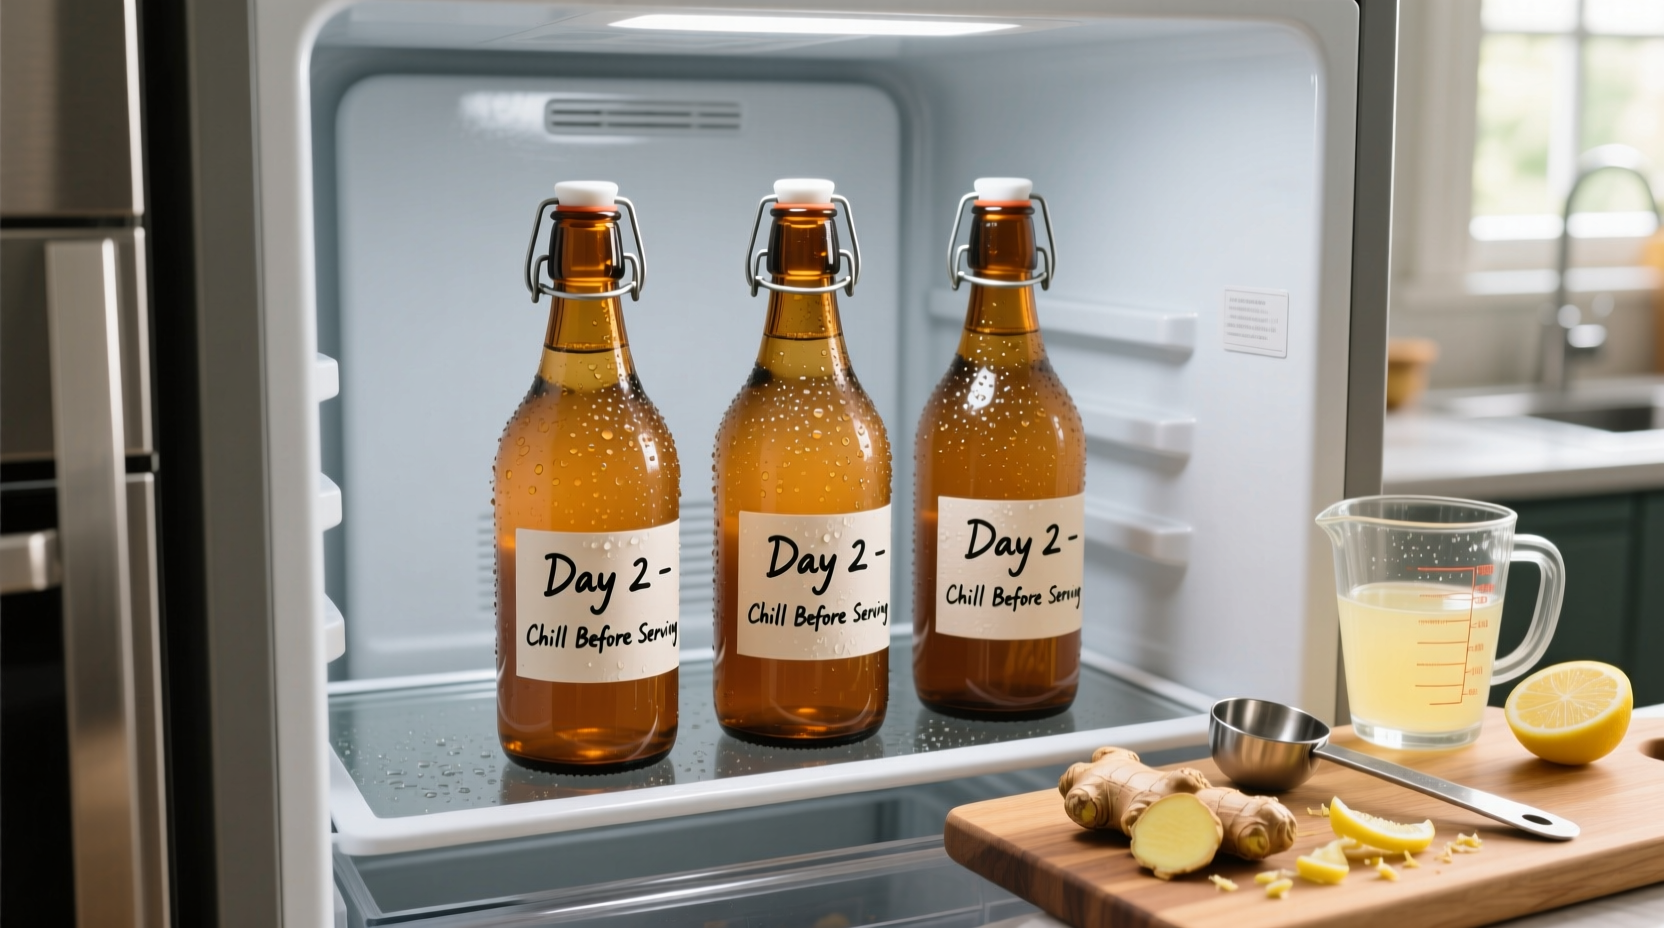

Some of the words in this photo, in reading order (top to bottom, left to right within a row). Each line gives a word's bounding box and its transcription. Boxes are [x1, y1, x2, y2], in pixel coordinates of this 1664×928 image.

[765, 534, 838, 597] Day
[964, 518, 1033, 578] Day
[543, 552, 617, 616] Day
[945, 583, 986, 607] Chill
[991, 585, 1042, 613] Before
[526, 622, 568, 649] Chill
[574, 624, 633, 655] Before
[747, 601, 788, 627] Chill
[793, 604, 847, 633] Before
